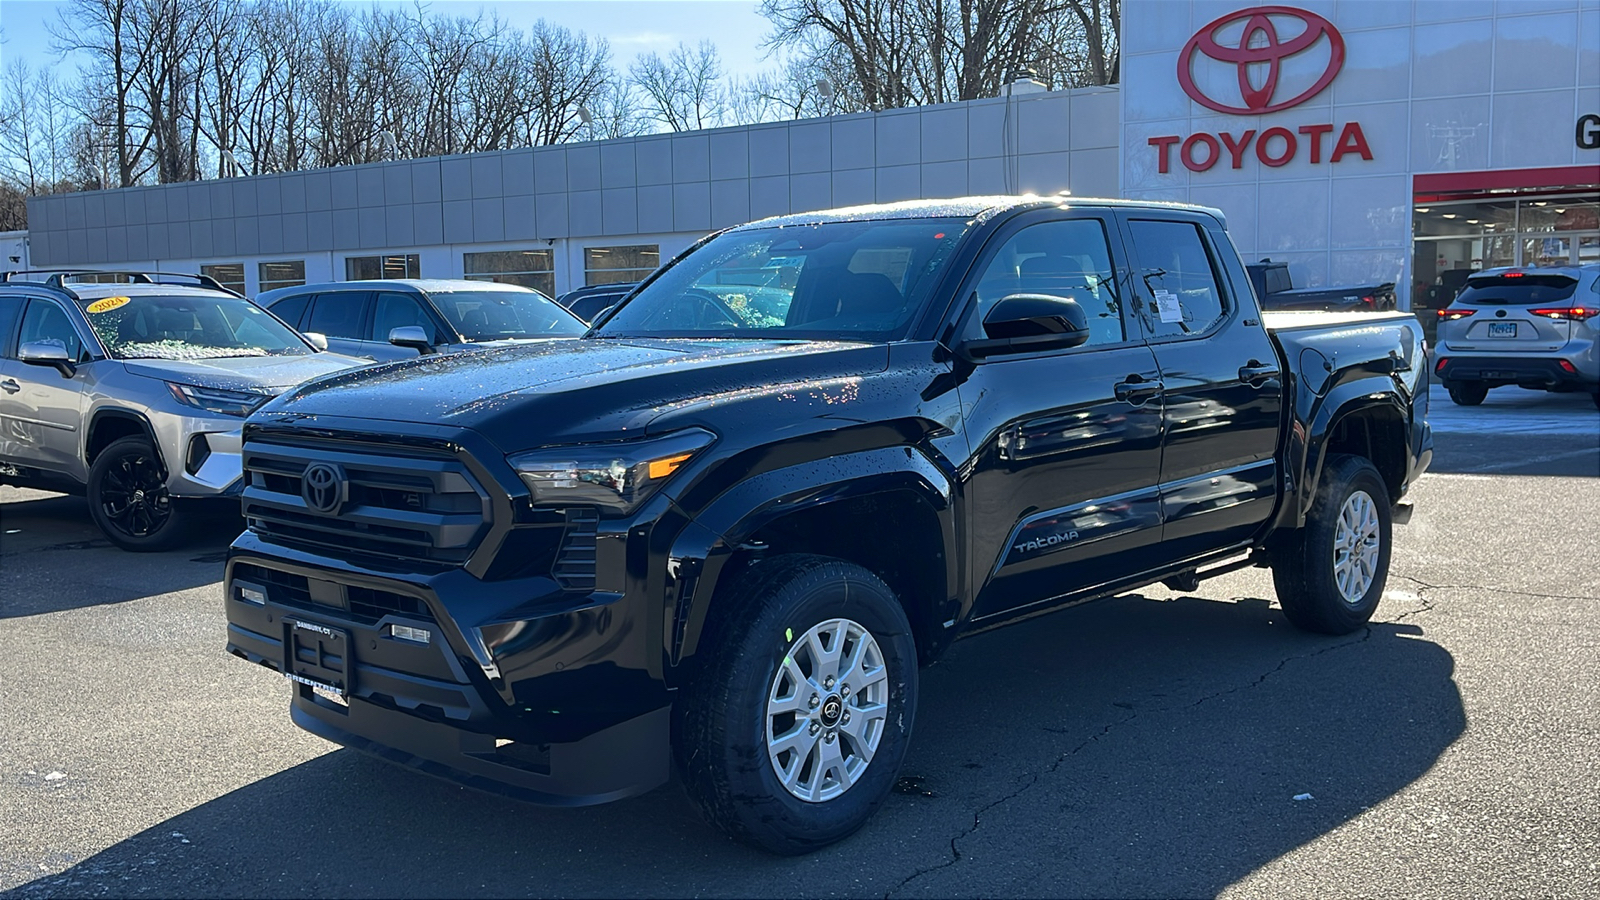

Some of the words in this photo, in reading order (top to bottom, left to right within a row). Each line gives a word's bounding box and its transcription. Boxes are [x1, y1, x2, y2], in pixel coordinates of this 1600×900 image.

[1148, 122, 1374, 173] TOYOTA
[94, 297, 124, 311] 2024
[1014, 530, 1079, 553] TACOMA
